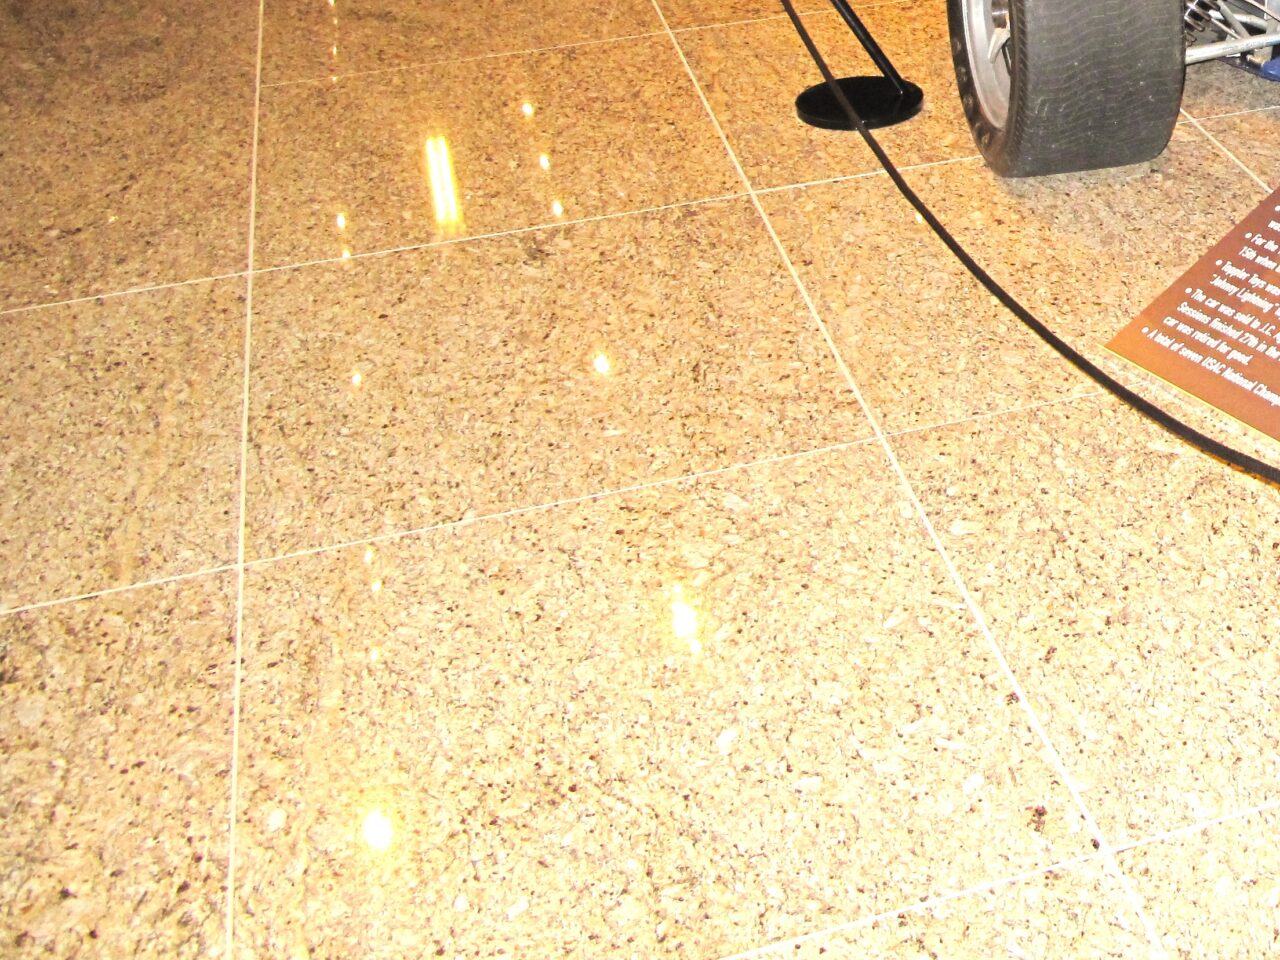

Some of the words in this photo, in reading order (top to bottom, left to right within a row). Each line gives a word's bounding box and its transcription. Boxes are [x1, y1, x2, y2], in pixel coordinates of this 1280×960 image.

[1251, 235, 1267, 245] For
[1264, 241, 1278, 252] the
[1255, 256, 1277, 269] when
[1249, 274, 1267, 288] Toys
